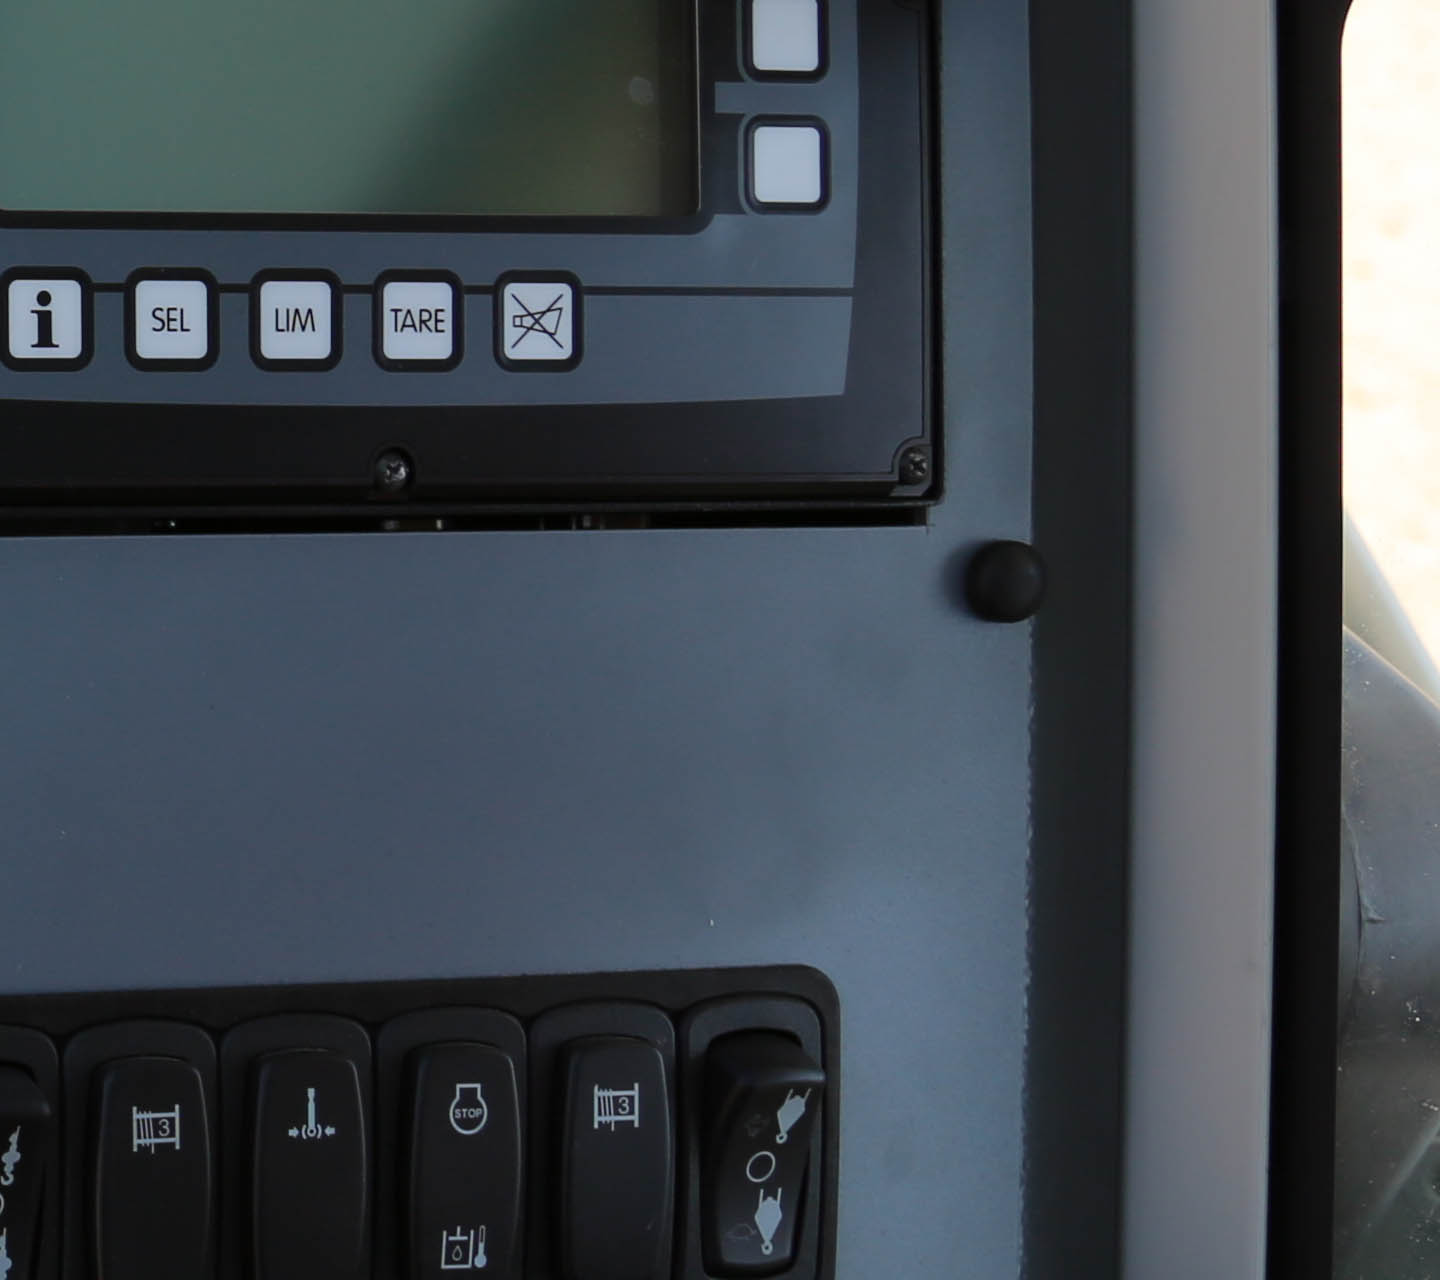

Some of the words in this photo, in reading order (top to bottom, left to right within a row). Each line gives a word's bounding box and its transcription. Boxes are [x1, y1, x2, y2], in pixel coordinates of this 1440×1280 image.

[151, 308, 191, 333] SEL
[275, 308, 316, 333] LIM
[391, 309, 446, 334] TARE
[454, 1108, 483, 1119] STOP
[618, 1096, 630, 1115] 3
[158, 1118, 170, 1137] 3
